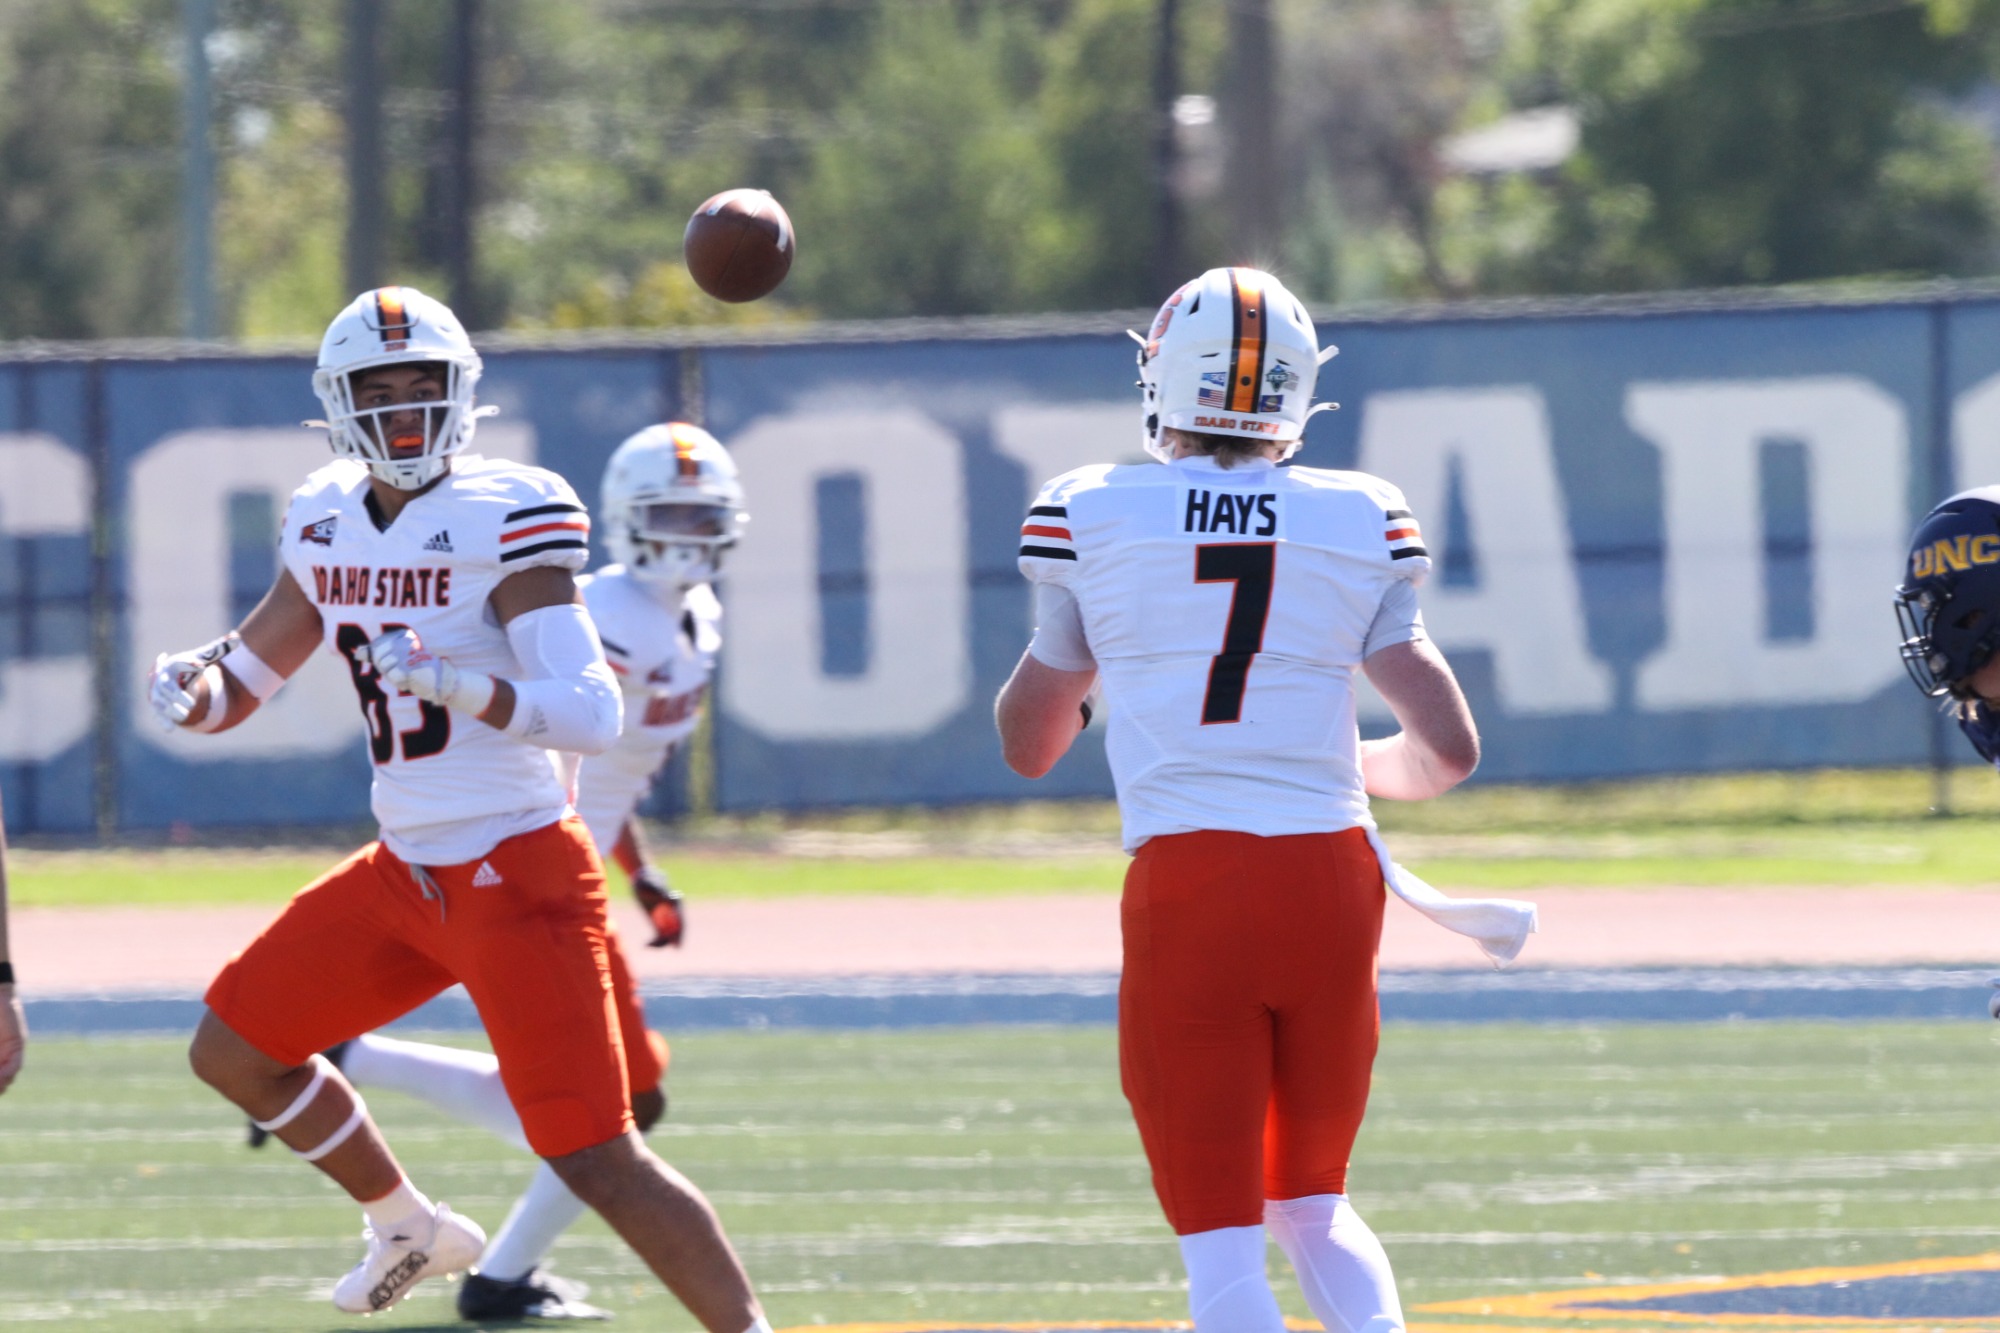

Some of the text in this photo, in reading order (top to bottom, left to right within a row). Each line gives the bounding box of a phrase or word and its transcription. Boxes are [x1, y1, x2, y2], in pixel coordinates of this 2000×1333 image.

[1194, 416, 1280, 434] IDAHO STATE
[1184, 488, 1277, 537] HAYS
[1912, 534, 2000, 579] UNC
[373, 567, 452, 608] STATE
[1194, 541, 1277, 726] 7
